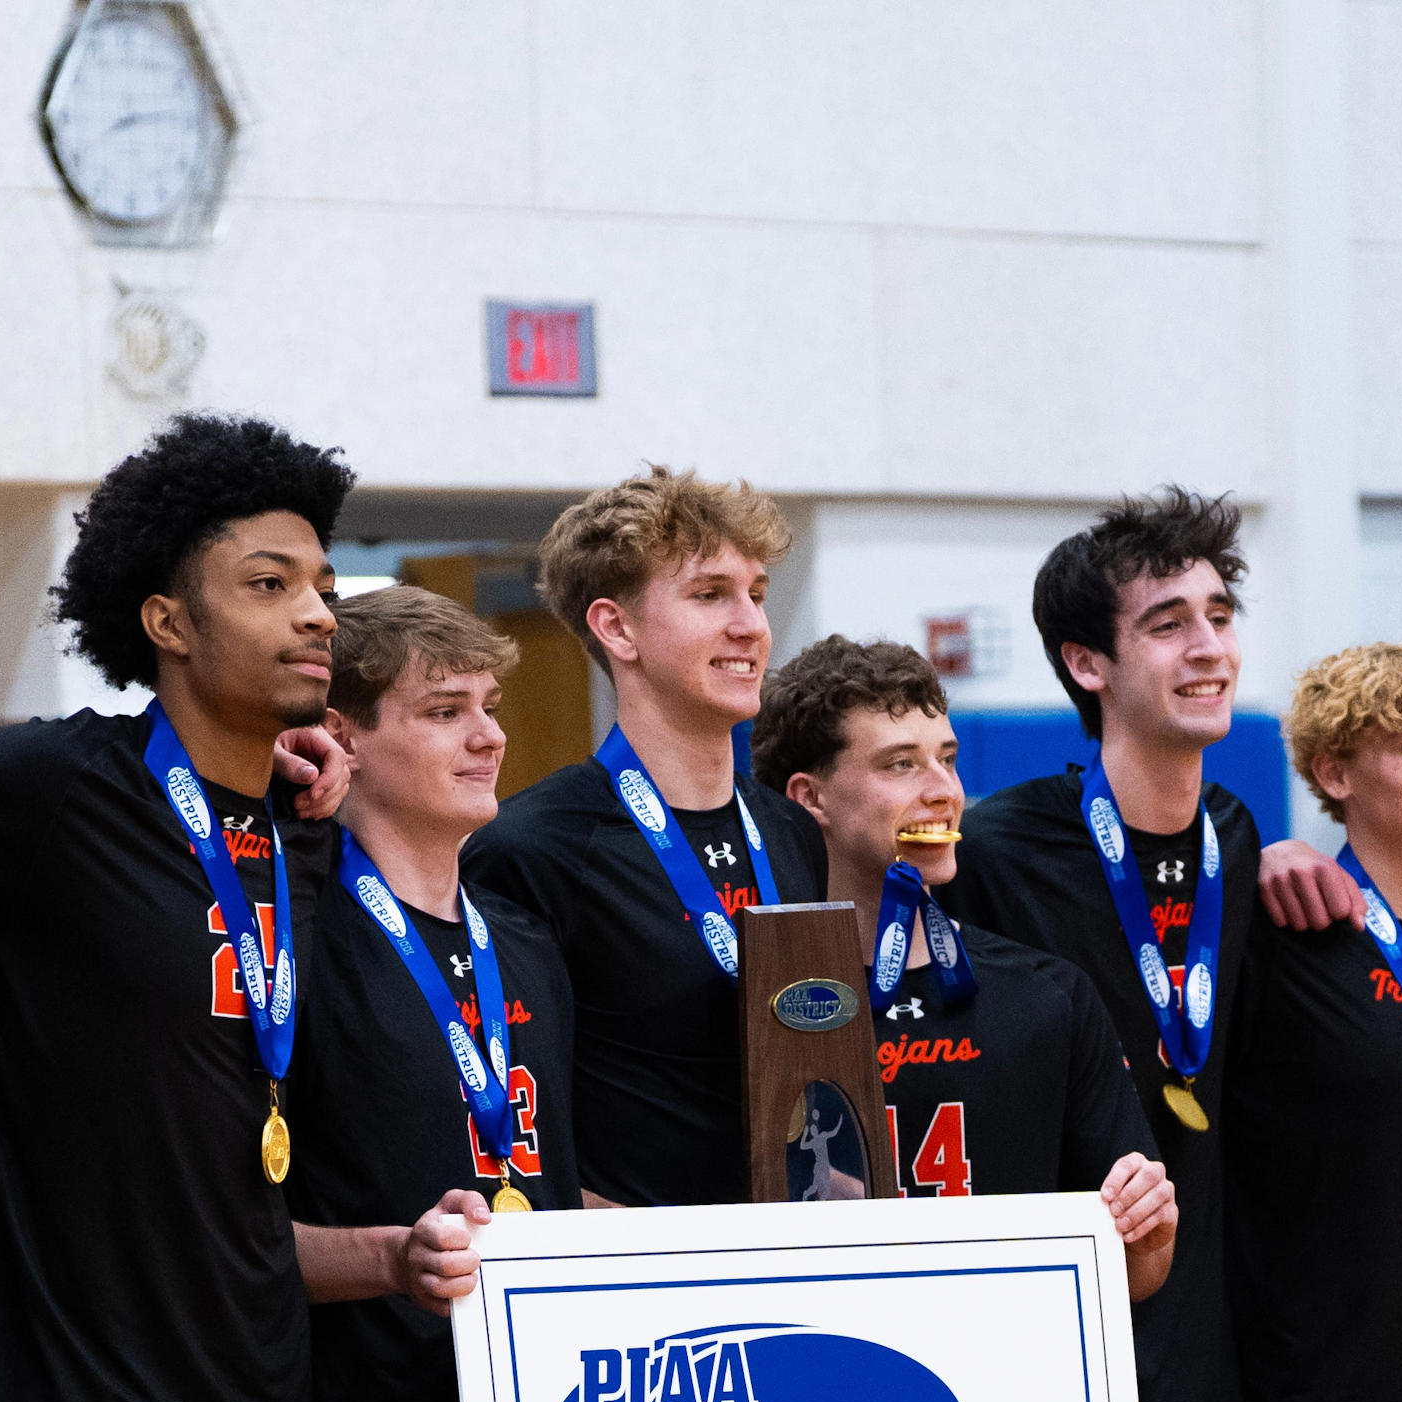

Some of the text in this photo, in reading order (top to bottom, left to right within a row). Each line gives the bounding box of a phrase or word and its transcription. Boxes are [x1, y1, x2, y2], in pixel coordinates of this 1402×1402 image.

[506, 309, 580, 384] EXIT
[165, 771, 209, 841] DISTRICT
[616, 772, 661, 834] DISTRICT
[1090, 803, 1119, 863] DISTRICT
[355, 881, 404, 938] DISTRICT
[926, 904, 950, 968] DISTRICT
[239, 934, 265, 1010] DISTRICT
[276, 950, 293, 1023] DISTRICT
[888, 923, 907, 990] DISTRICT
[1139, 949, 1167, 1009] DISTRICT
[784, 1000, 839, 1017] DISTRICT
[447, 1025, 483, 1092] DISTRICT
[877, 1034, 981, 1082] ojans
